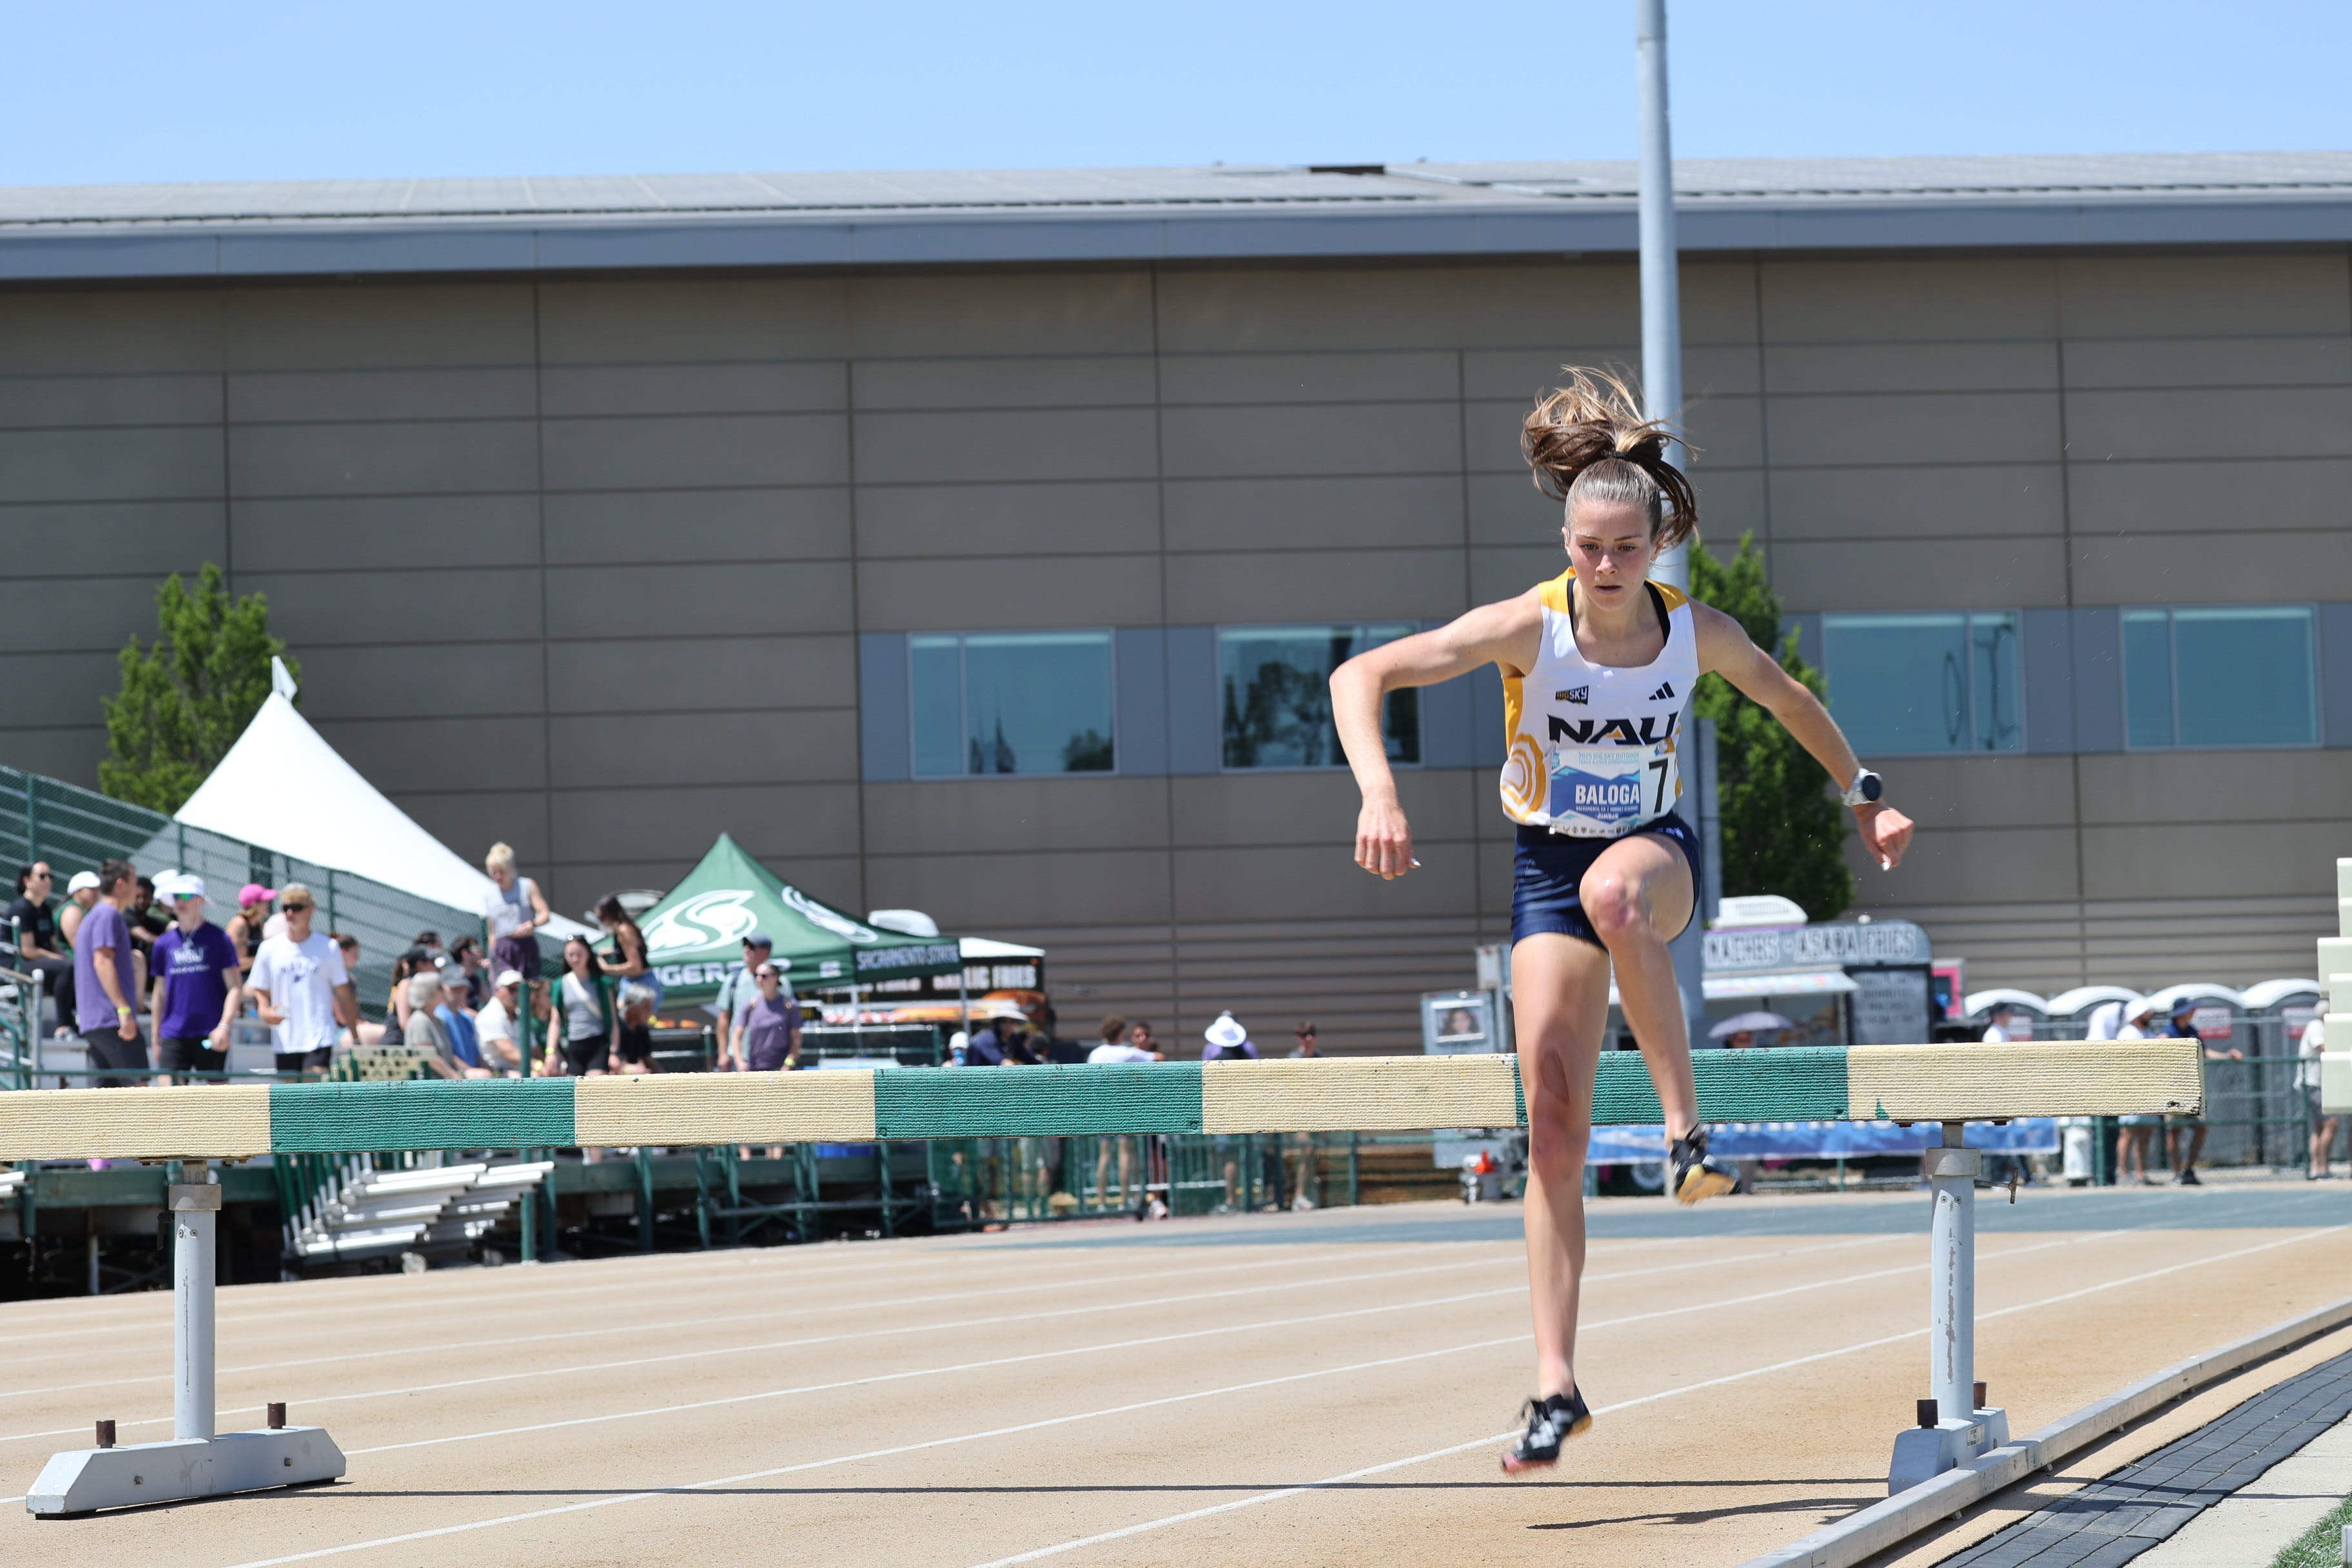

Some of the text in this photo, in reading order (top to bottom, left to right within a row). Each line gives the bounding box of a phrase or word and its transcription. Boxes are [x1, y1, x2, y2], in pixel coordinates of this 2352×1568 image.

[1547, 710, 1678, 745] NAU
[1575, 783, 1640, 805] BALOGA
[1649, 758, 1669, 814] 7
